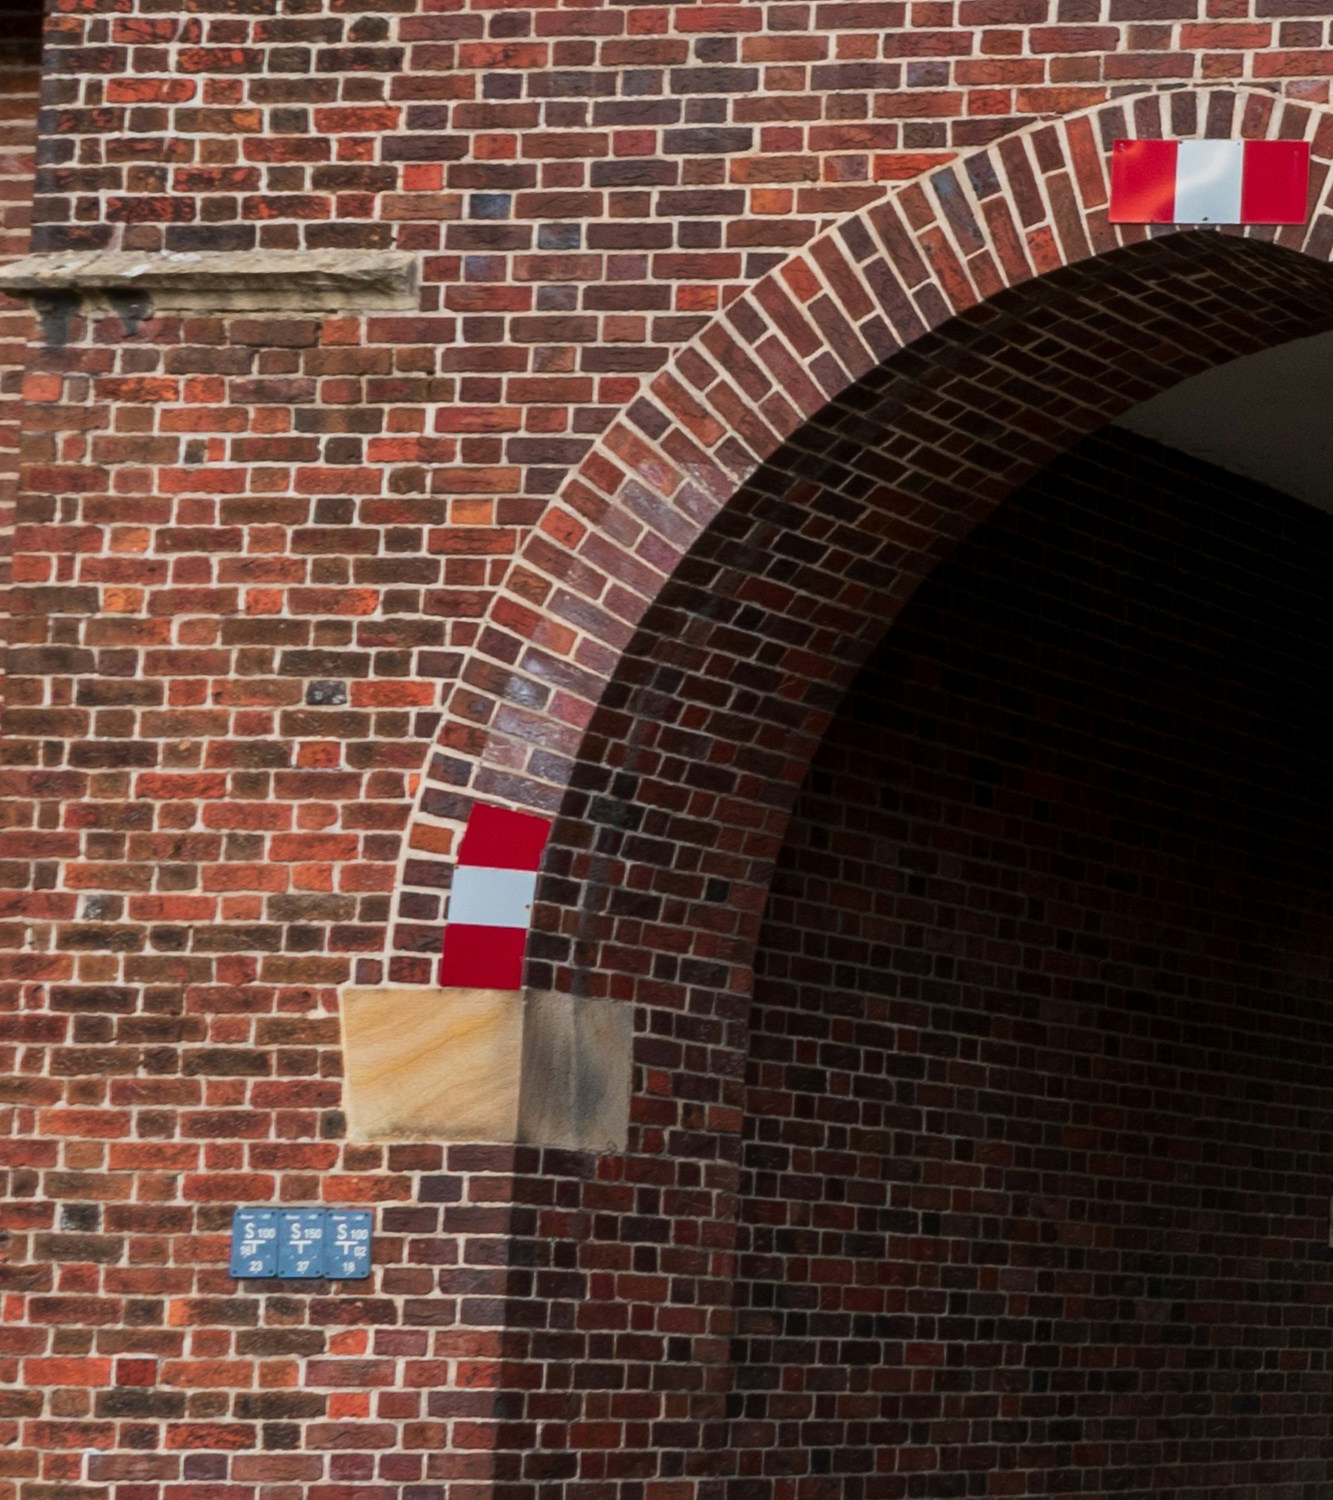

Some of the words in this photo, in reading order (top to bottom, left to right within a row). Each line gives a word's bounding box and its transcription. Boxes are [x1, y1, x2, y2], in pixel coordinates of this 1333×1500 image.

[244, 1222, 255, 1239] S
[291, 1222, 301, 1239] S
[337, 1223, 348, 1240] S
